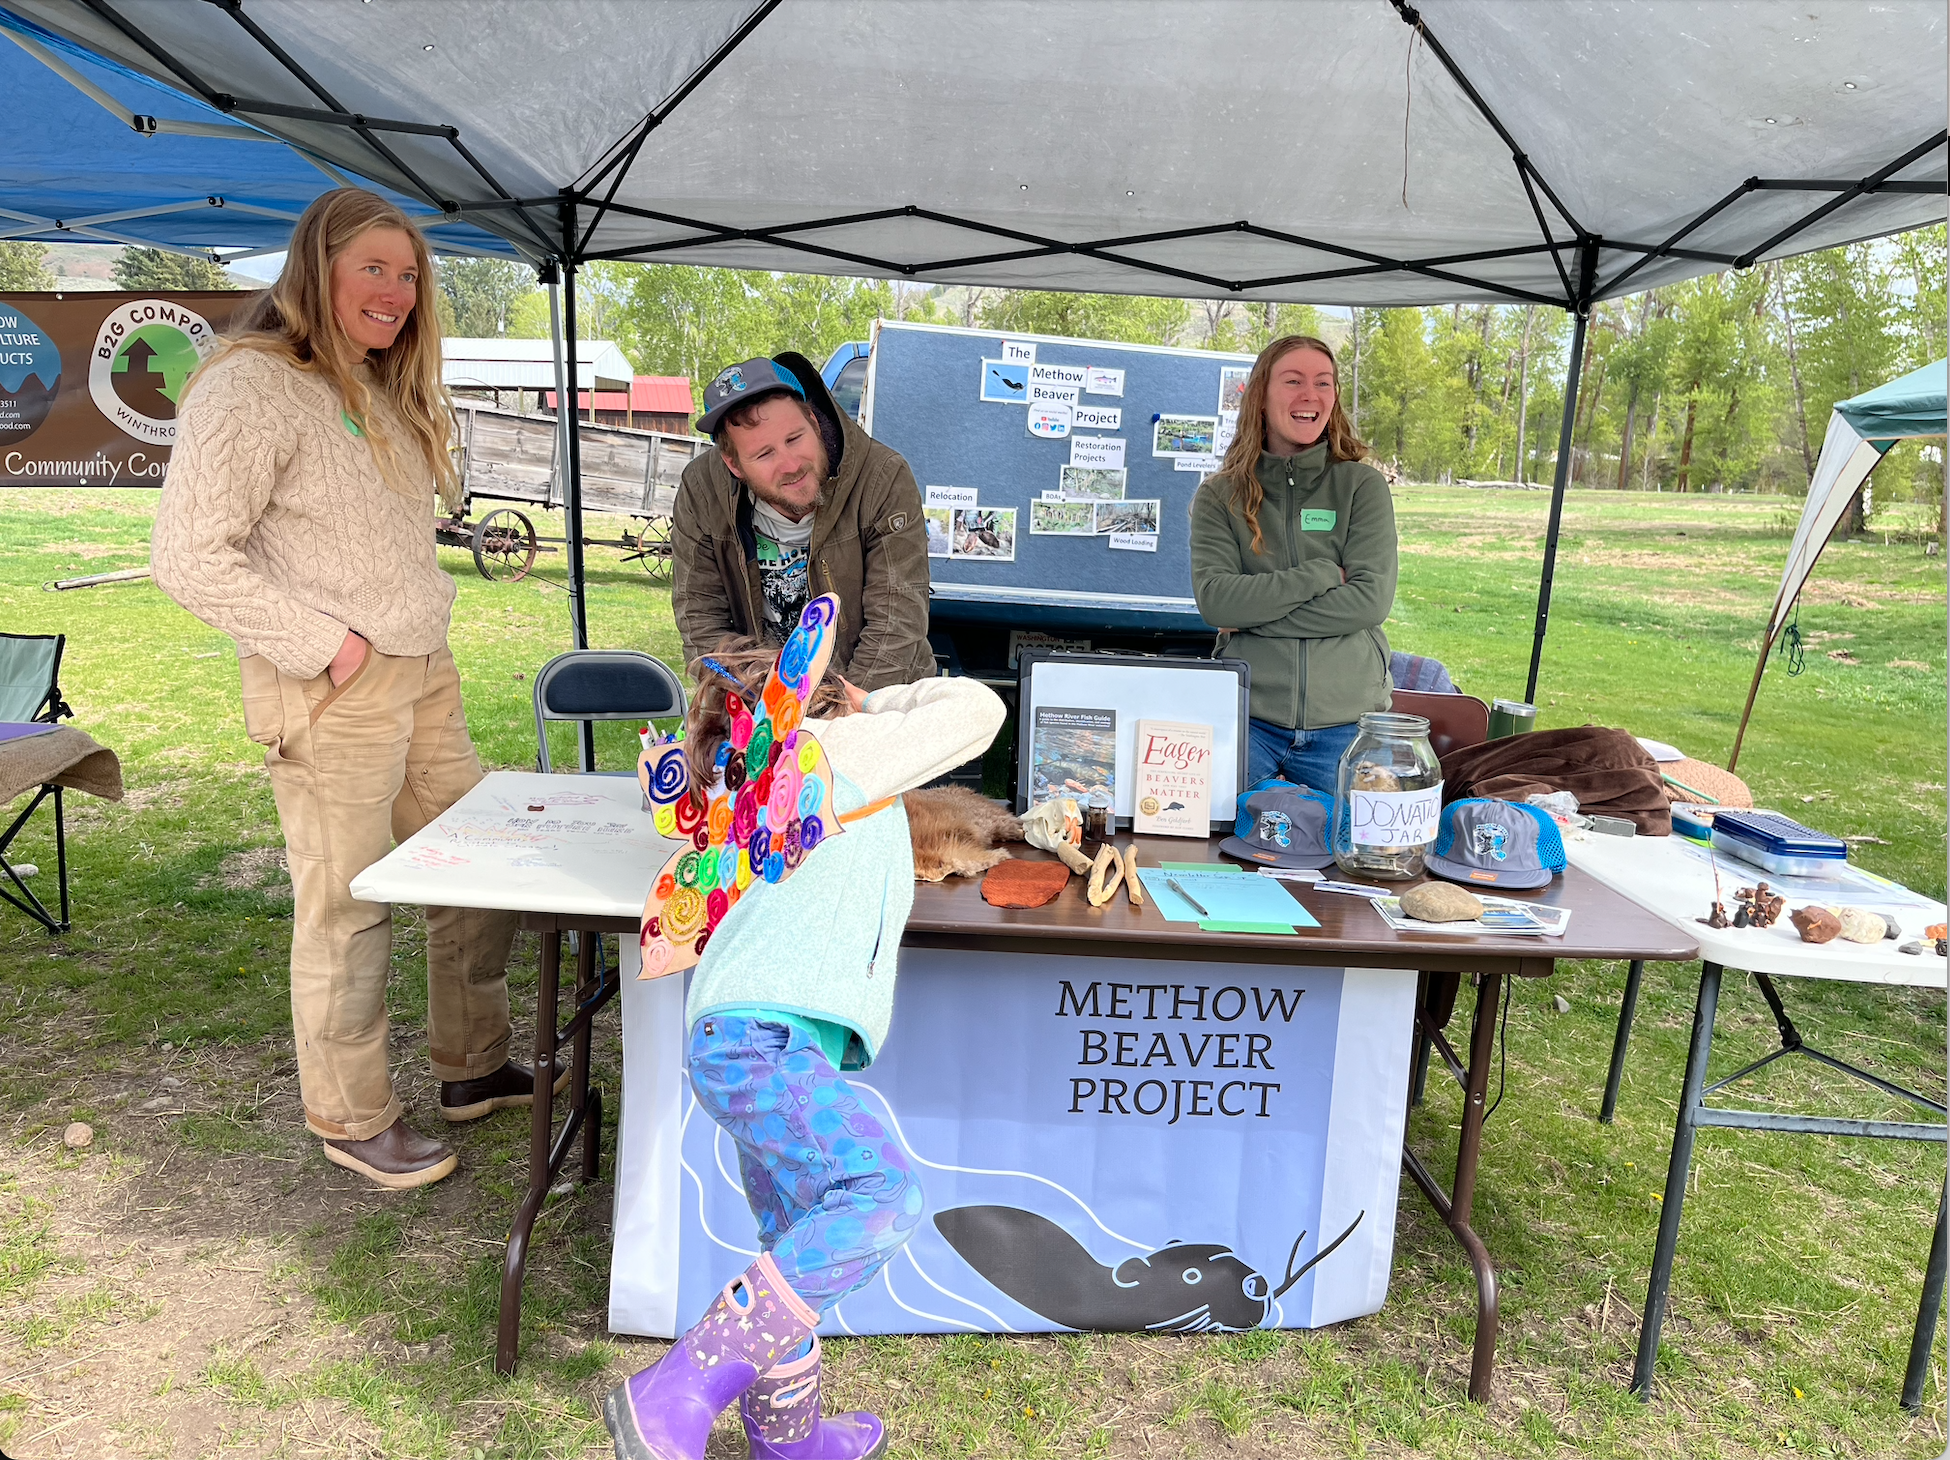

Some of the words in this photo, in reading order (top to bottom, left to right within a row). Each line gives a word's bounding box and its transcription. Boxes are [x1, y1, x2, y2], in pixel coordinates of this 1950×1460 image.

[98, 321, 125, 360] B2G
[0, 352, 33, 365] UCTS
[1008, 346, 1031, 359] The
[1032, 367, 1083, 382] Methow
[1034, 387, 1075, 401] Beaver
[1076, 411, 1117, 425] Project
[1075, 440, 1121, 452] Restoration
[1074, 453, 1106, 463] Projects
[1177, 460, 1192, 468] Pond
[5, 451, 122, 486] Community
[930, 491, 973, 502] Relocation
[1304, 513, 1330, 525] Emma
[1113, 537, 1131, 545] Wood
[1131, 539, 1154, 548] Loading
[1142, 733, 1211, 770] Eager
[1146, 774, 1205, 786] BEAVERS
[1149, 787, 1201, 799] MATTER
[1354, 795, 1439, 828] DONATIO
[1380, 828, 1422, 844] JAR
[1055, 980, 1305, 1022] METHOW
[1078, 1030, 1275, 1070] BEAVER
[1067, 1078, 1281, 1125] PROJECT
